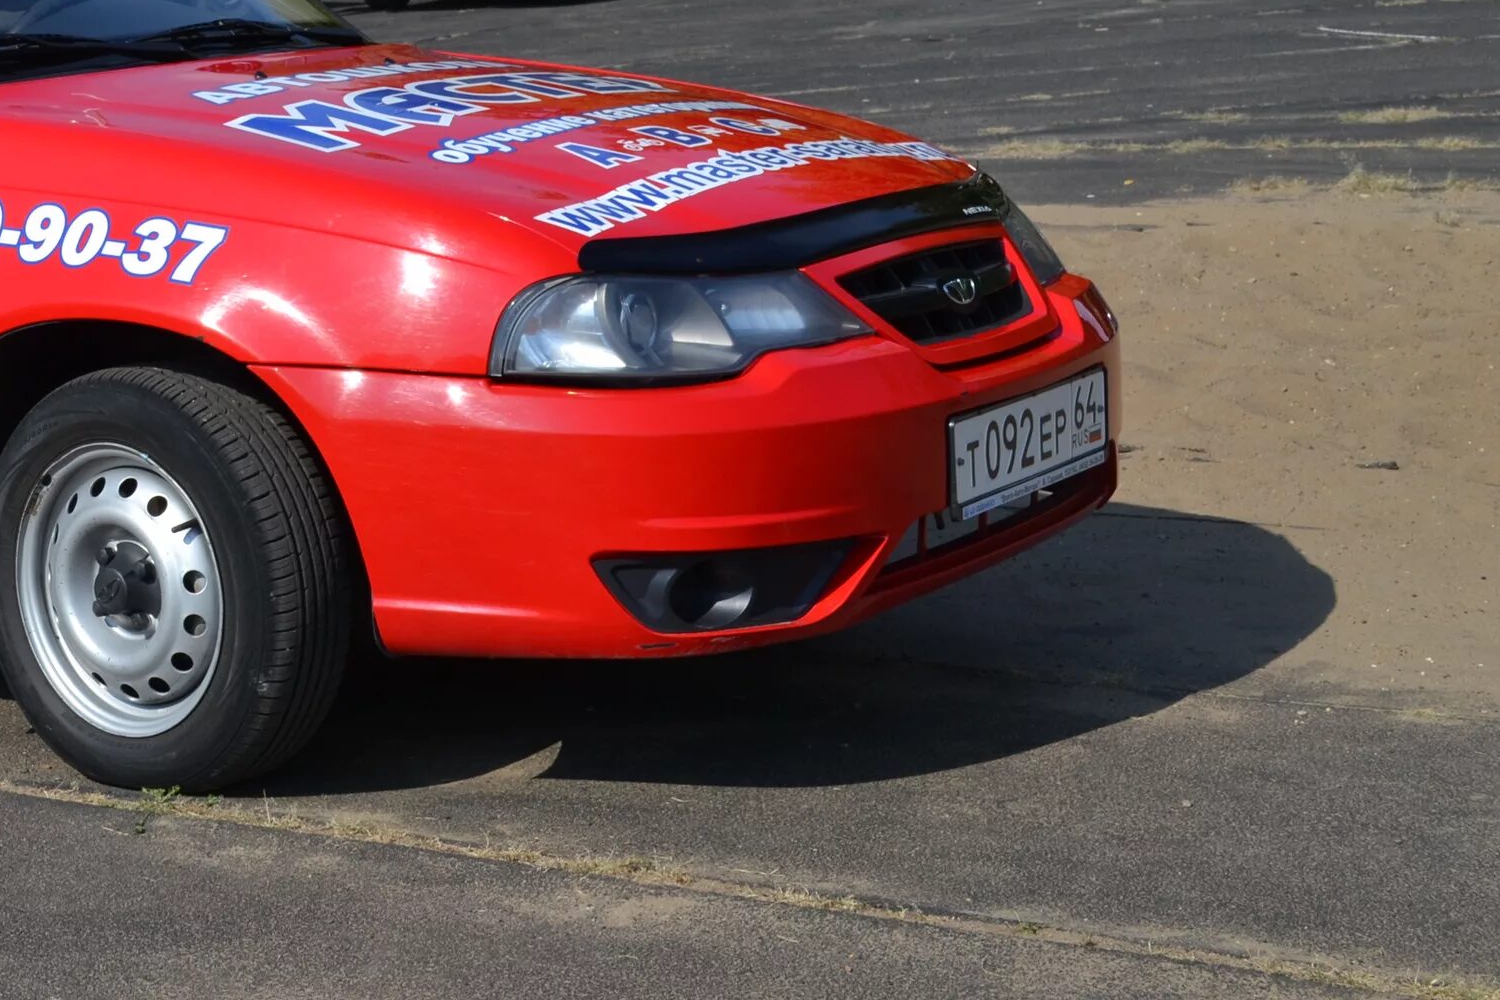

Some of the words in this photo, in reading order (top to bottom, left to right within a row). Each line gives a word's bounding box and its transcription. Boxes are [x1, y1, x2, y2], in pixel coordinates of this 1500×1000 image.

[430, 114, 598, 164] обучение
[1073, 380, 1097, 430] 64
[1071, 429, 1090, 448] RUS
